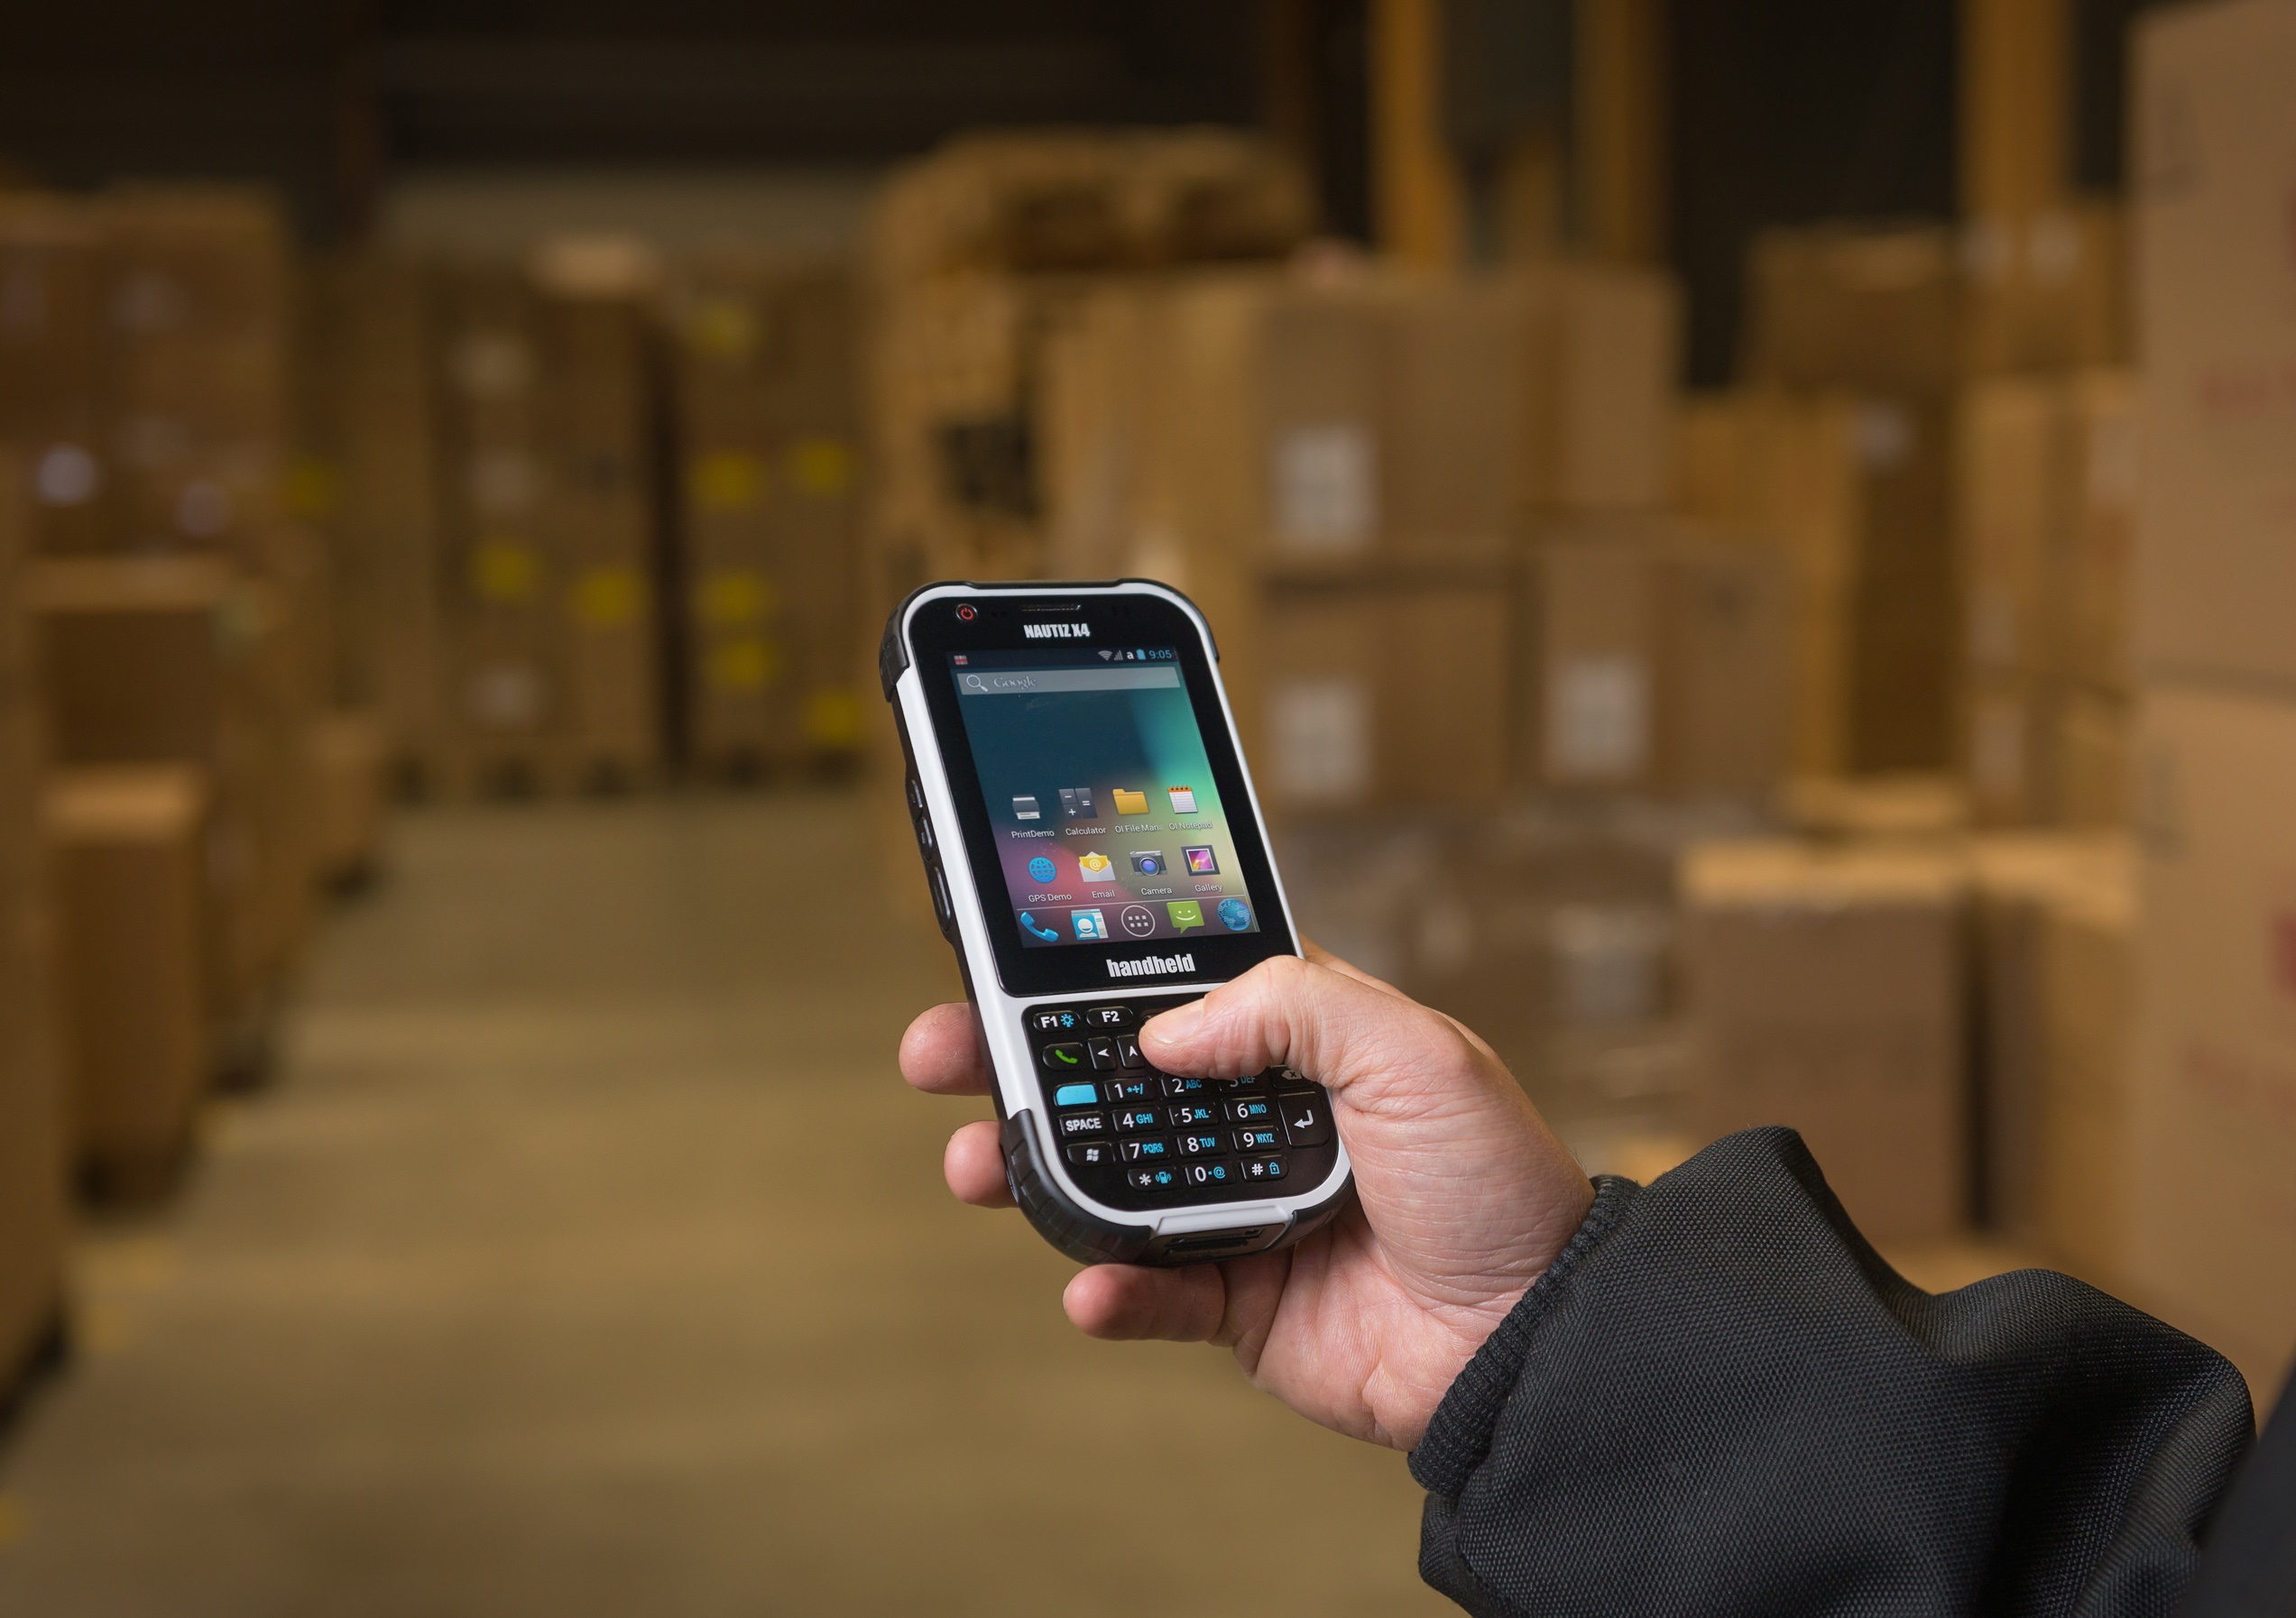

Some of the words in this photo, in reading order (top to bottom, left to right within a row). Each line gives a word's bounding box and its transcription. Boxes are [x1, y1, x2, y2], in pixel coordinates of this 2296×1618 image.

[1023, 623, 1072, 639] NAUTIZ
[1072, 623, 1091, 637] X4
[1148, 649, 1172, 660] 9:05
[993, 676, 1037, 690] Google
[1065, 826, 1106, 836] Calculator
[1125, 824, 1140, 832] File
[1179, 821, 1213, 830] Notepad
[1011, 829, 1055, 839] PrintDemo
[1092, 889, 1115, 898] Email
[1140, 887, 1173, 896] Camera
[1194, 883, 1223, 893] Gallery
[1047, 893, 1072, 902] Demo
[1106, 953, 1196, 978] handheld
[1040, 1016, 1059, 1028] F1
[1102, 1010, 1120, 1023] F2
[1114, 1083, 1124, 1099] 1
[1171, 1079, 1185, 1093] 2
[1185, 1079, 1203, 1089] ABC
[1237, 1103, 1249, 1118] 6
[1249, 1103, 1268, 1115] MNO
[1065, 1117, 1102, 1132] SPACE
[1122, 1113, 1135, 1128] 4
[1135, 1113, 1154, 1124] GHI
[1187, 1136, 1200, 1153] 8
[1198, 1136, 1215, 1148] TUV
[1243, 1132, 1254, 1147] 9
[1255, 1133, 1274, 1144] WXYZ
[1129, 1142, 1140, 1159] 7
[1142, 1142, 1165, 1154] PQRS
